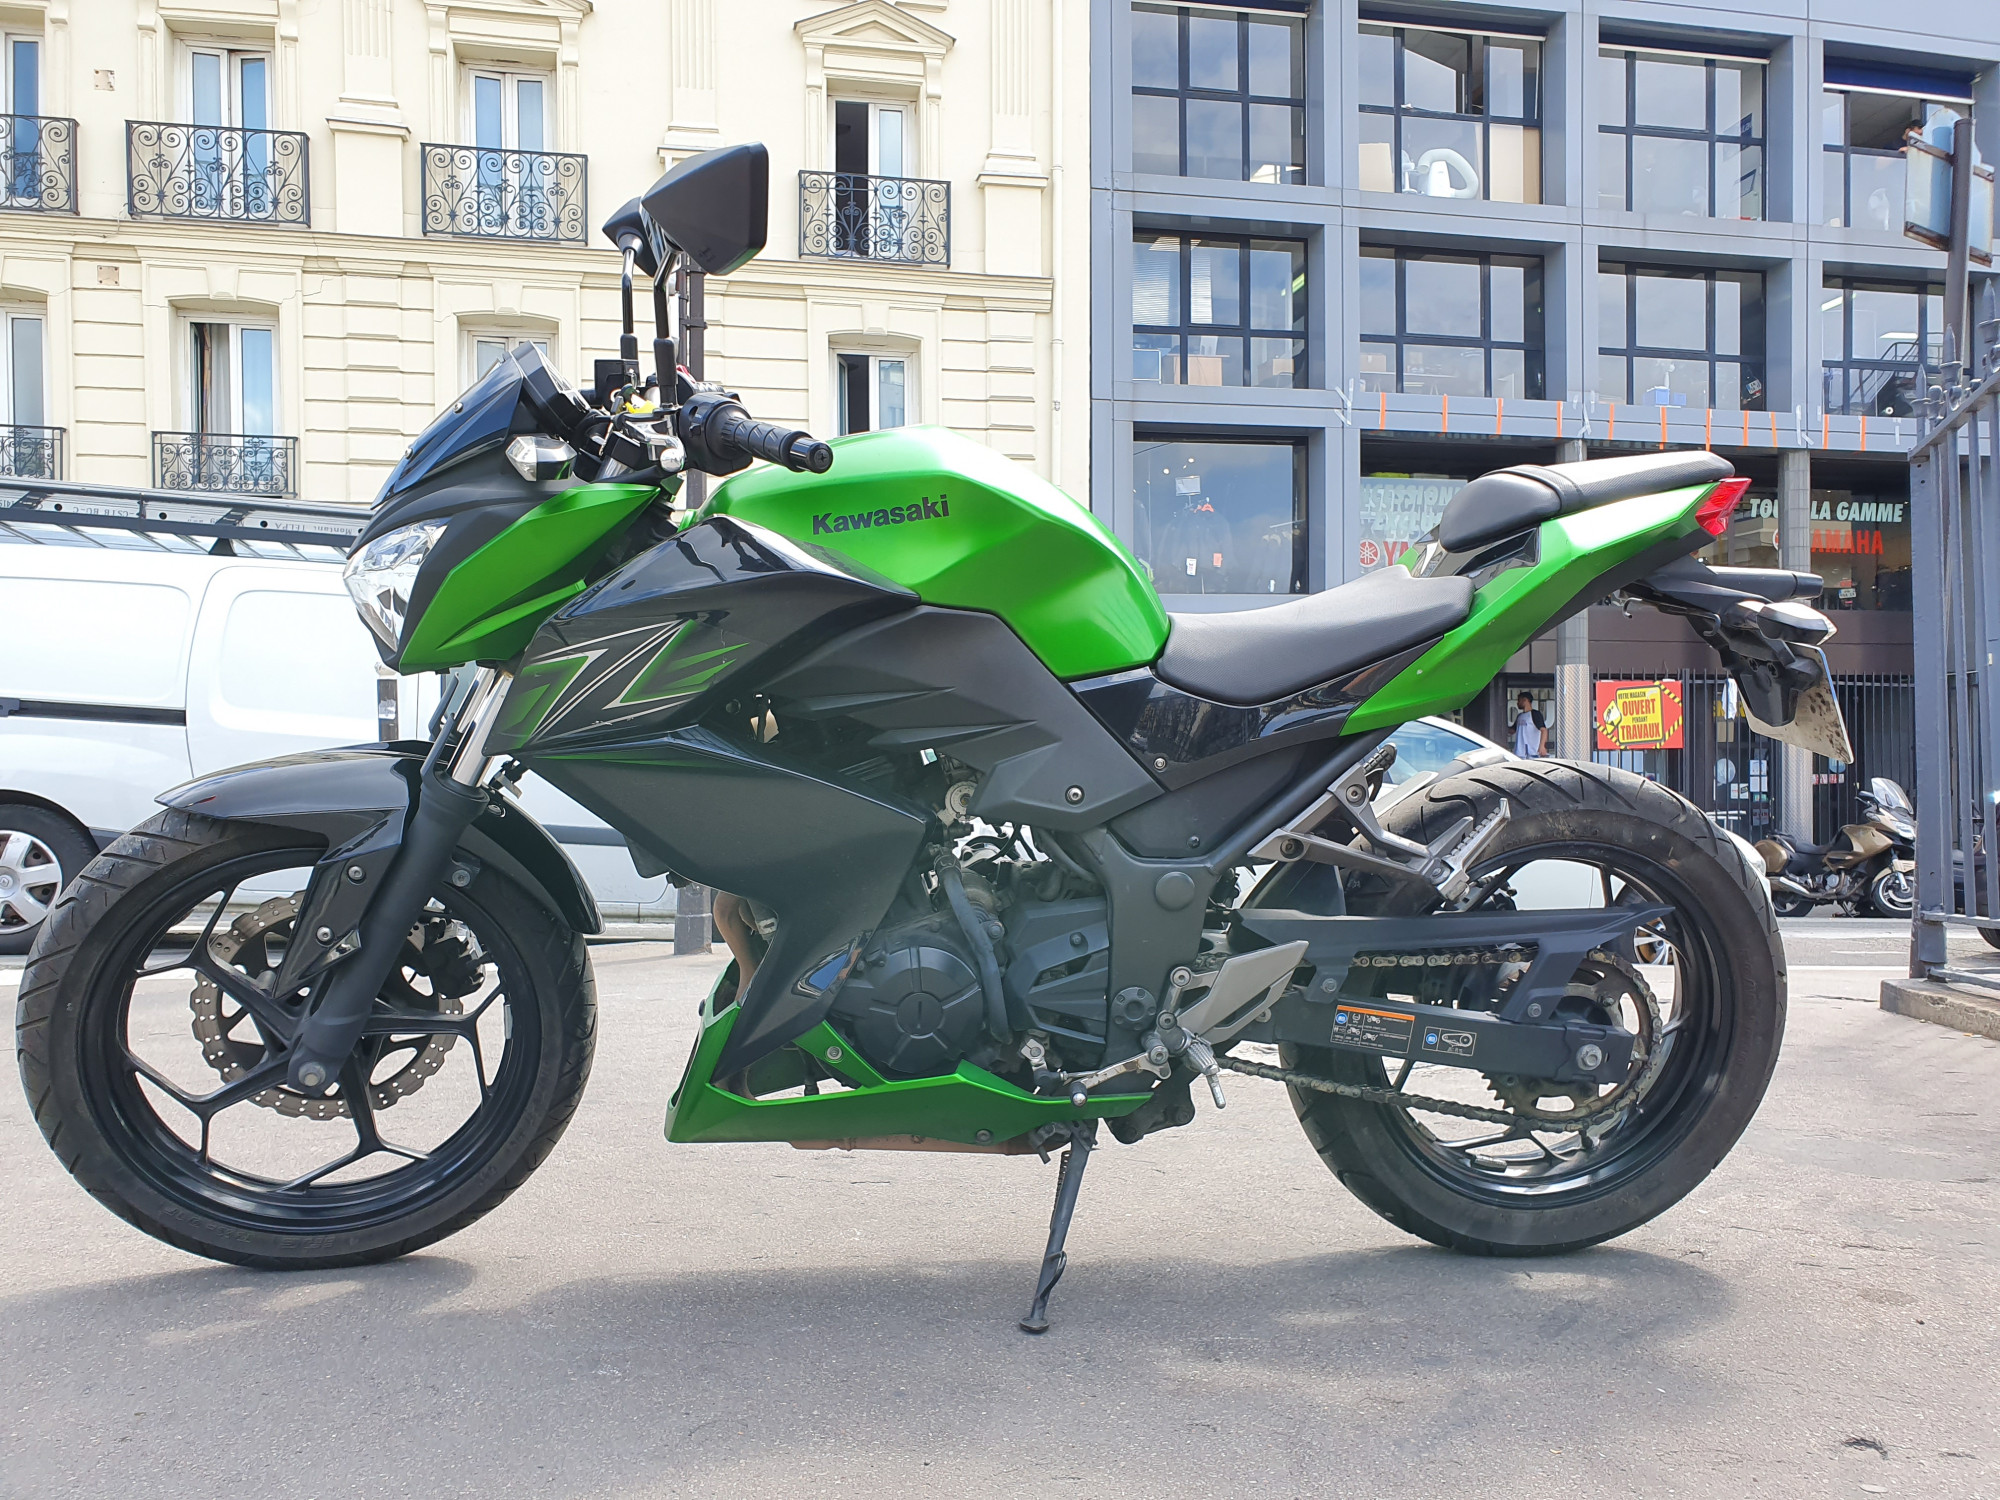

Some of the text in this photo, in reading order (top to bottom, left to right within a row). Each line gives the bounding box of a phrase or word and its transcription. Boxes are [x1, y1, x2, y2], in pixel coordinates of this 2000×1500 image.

[812, 494, 950, 535] Kawasaki
[1810, 500, 1831, 520] LA
[1836, 501, 1904, 523] GAMME
[1811, 529, 1884, 554] AMAHA
[1622, 699, 1656, 717] OUVERT
[1620, 723, 1661, 740] TRAVAUX
